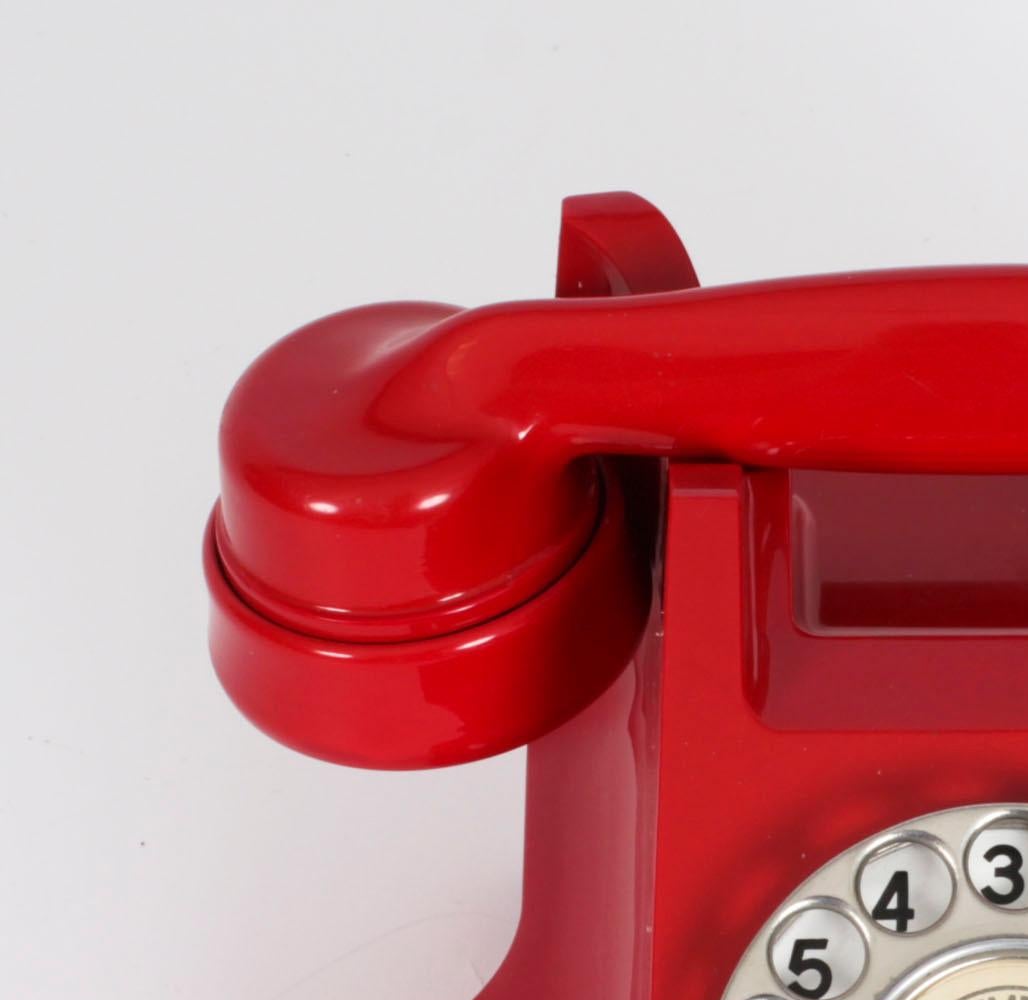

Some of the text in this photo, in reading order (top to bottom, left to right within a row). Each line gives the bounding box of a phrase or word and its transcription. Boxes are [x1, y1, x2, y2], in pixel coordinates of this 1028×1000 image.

[871, 870, 915, 933] 4
[981, 844, 1025, 905] 3
[787, 938, 833, 1000] 5
